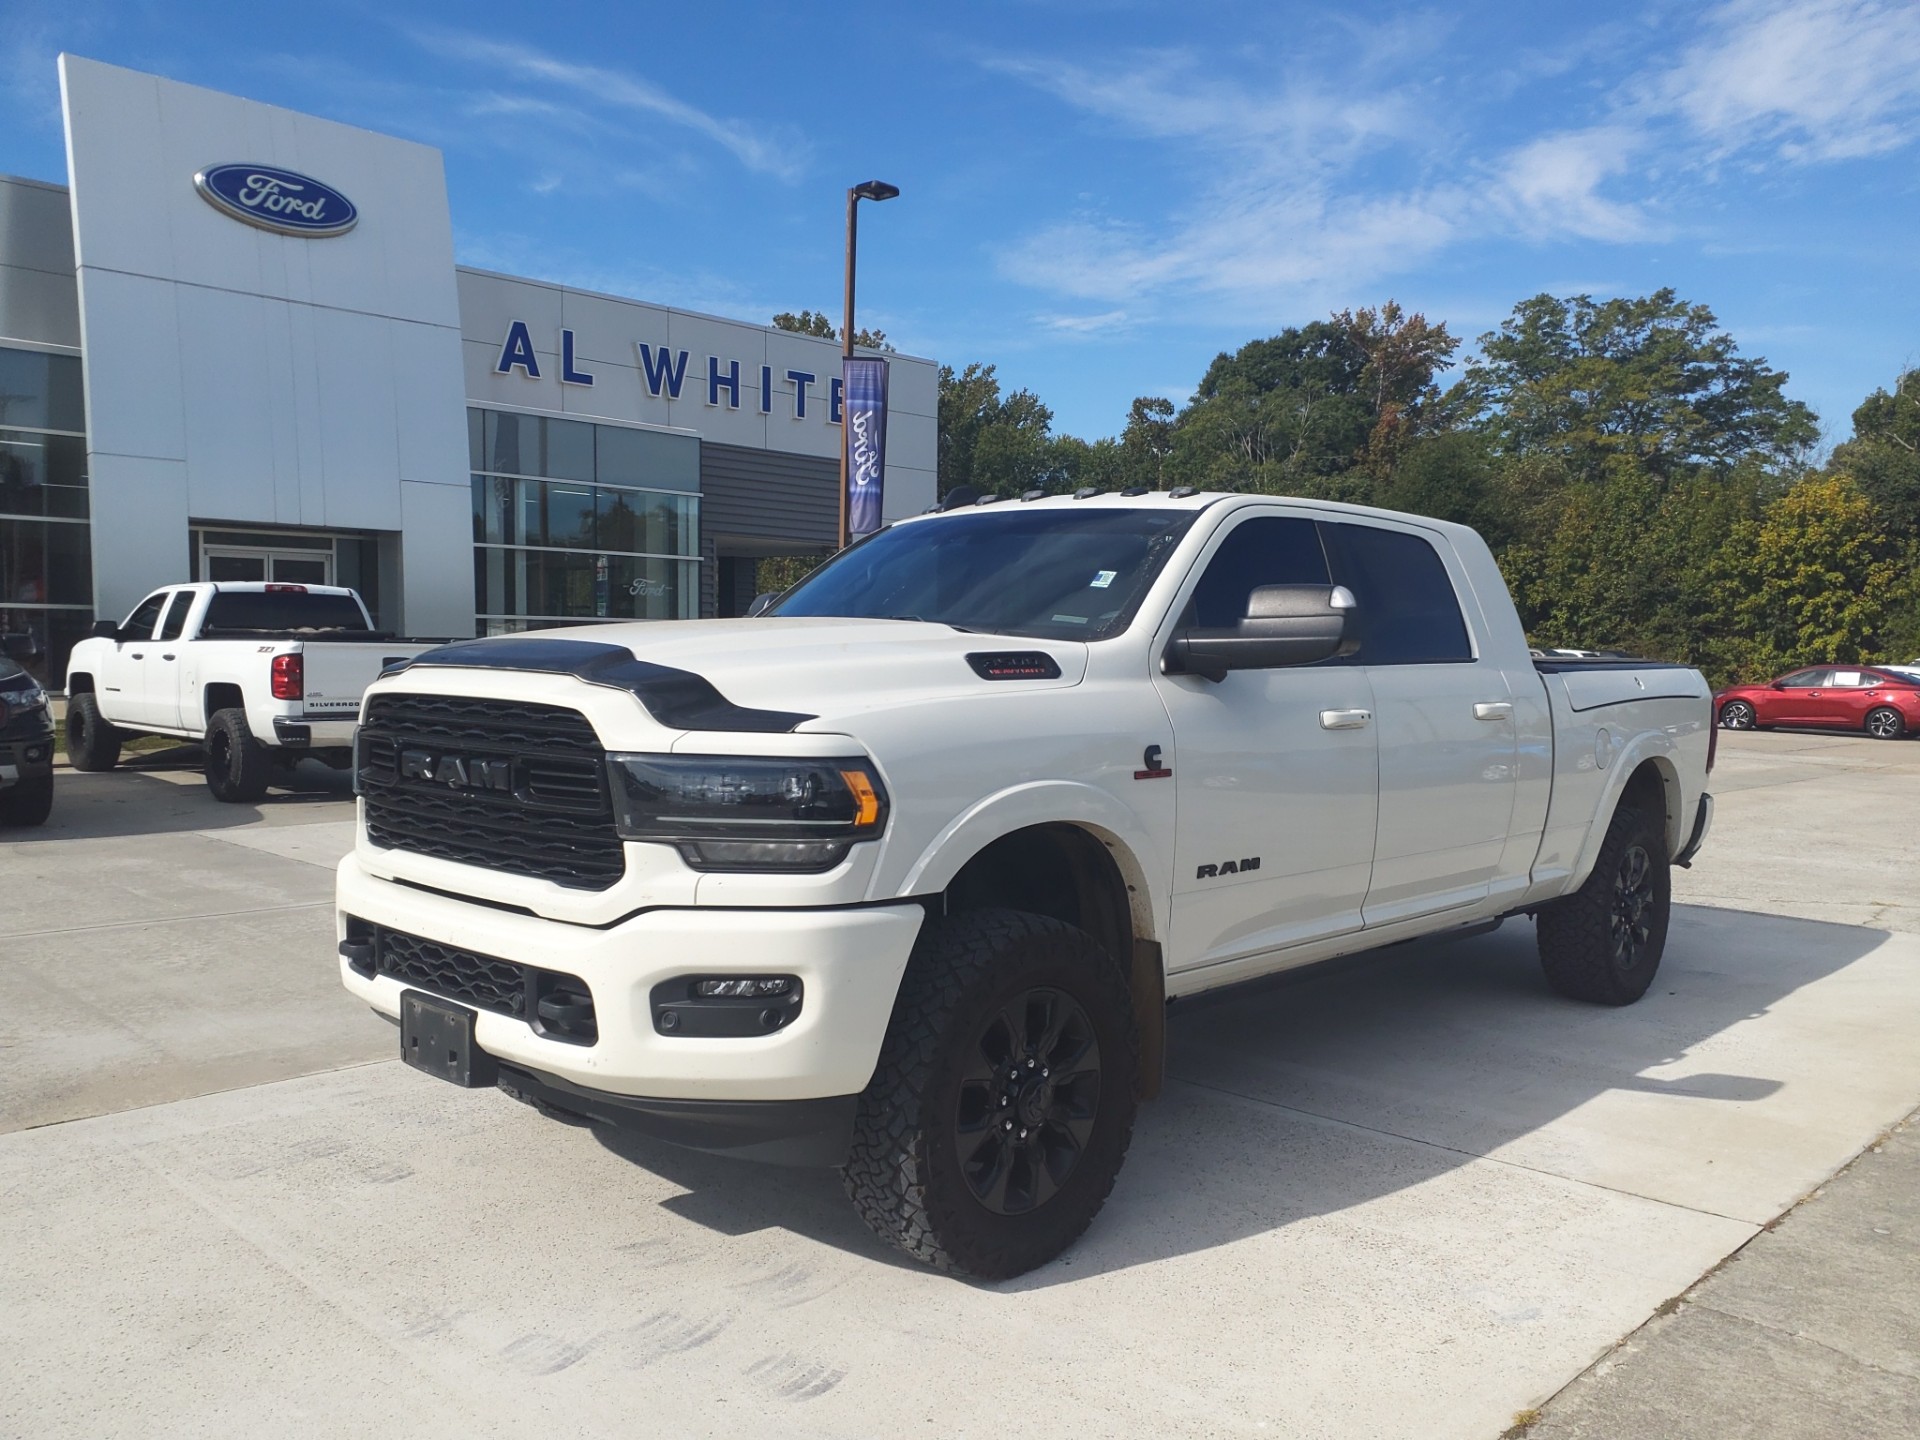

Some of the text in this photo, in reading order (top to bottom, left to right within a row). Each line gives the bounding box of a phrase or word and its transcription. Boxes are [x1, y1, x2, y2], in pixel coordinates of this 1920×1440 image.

[239, 174, 326, 220] Ford
[496, 320, 595, 387] AL
[629, 578, 666, 596] Ford
[402, 750, 511, 791] RAM
[1196, 856, 1261, 880] RAM
